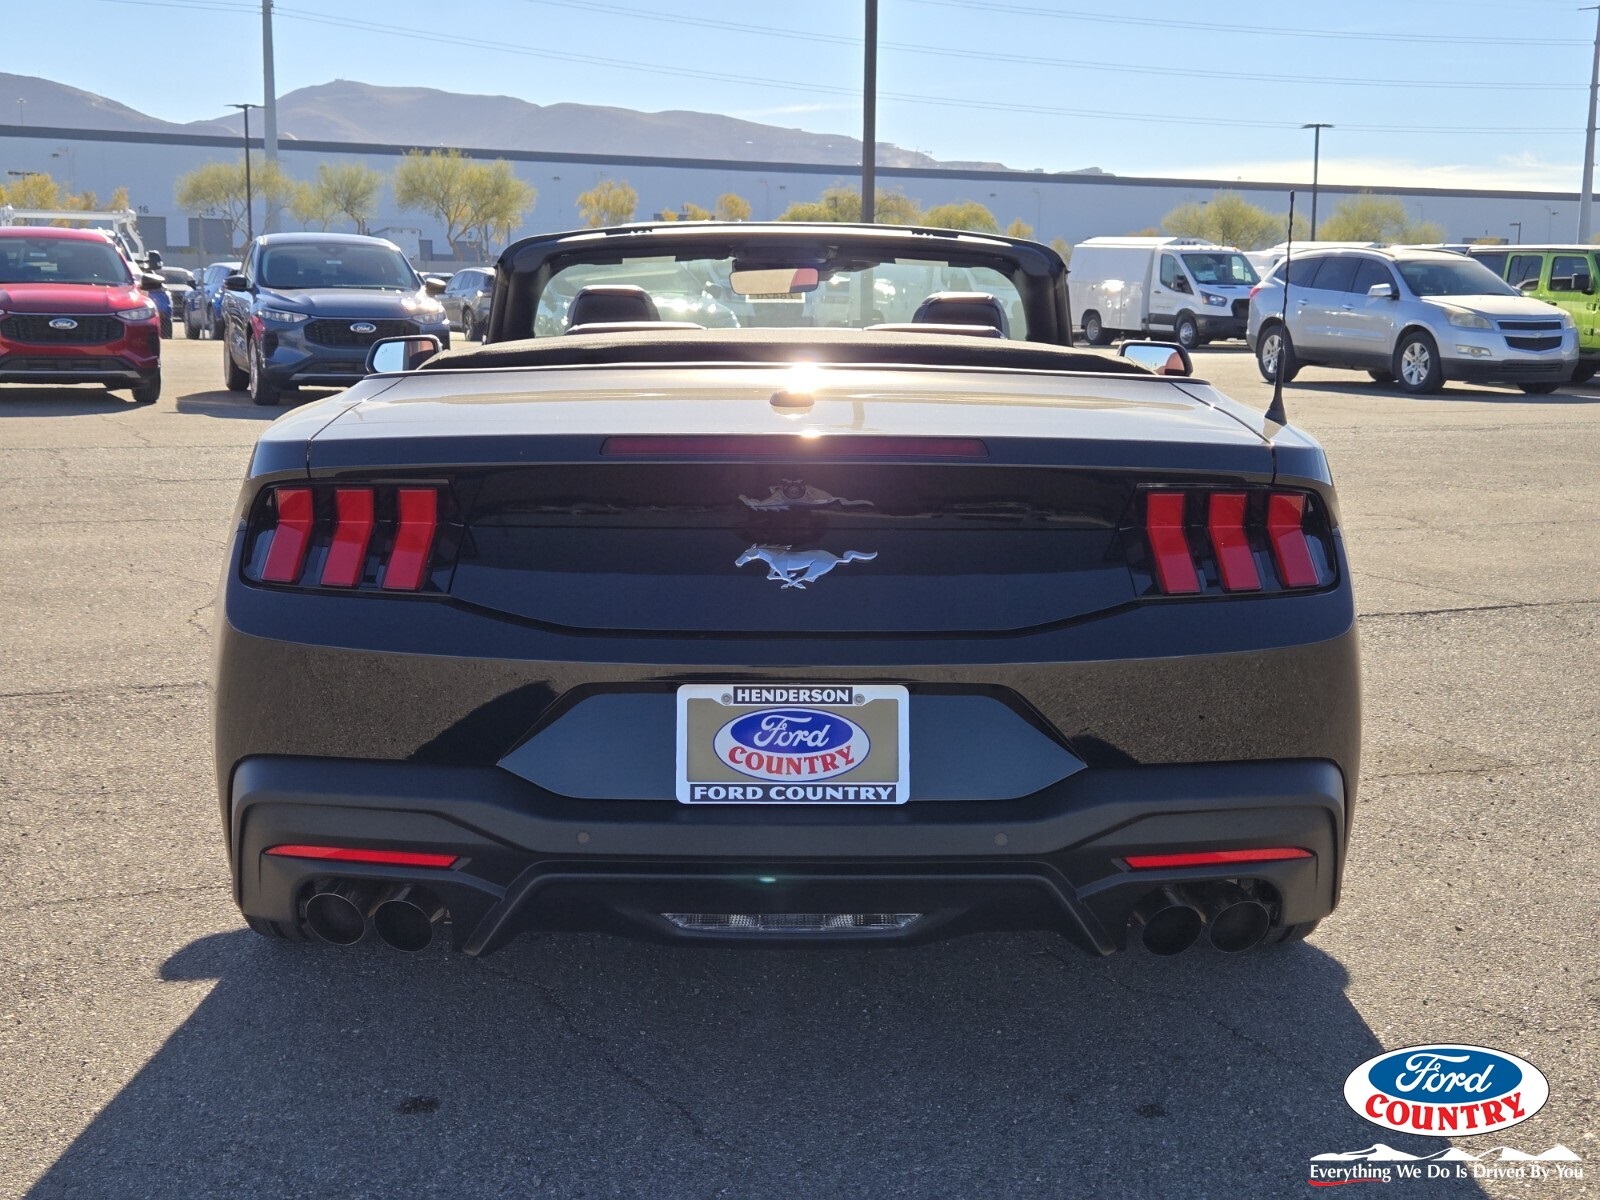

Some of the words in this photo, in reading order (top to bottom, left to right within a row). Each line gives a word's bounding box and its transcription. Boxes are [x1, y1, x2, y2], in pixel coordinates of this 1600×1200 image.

[137, 205, 149, 214] 16
[737, 689, 849, 702] HENDERSON
[753, 714, 831, 747] Ford
[728, 745, 855, 775] COUNTRY
[694, 786, 763, 800] FORD
[769, 786, 893, 800] COUNTRY
